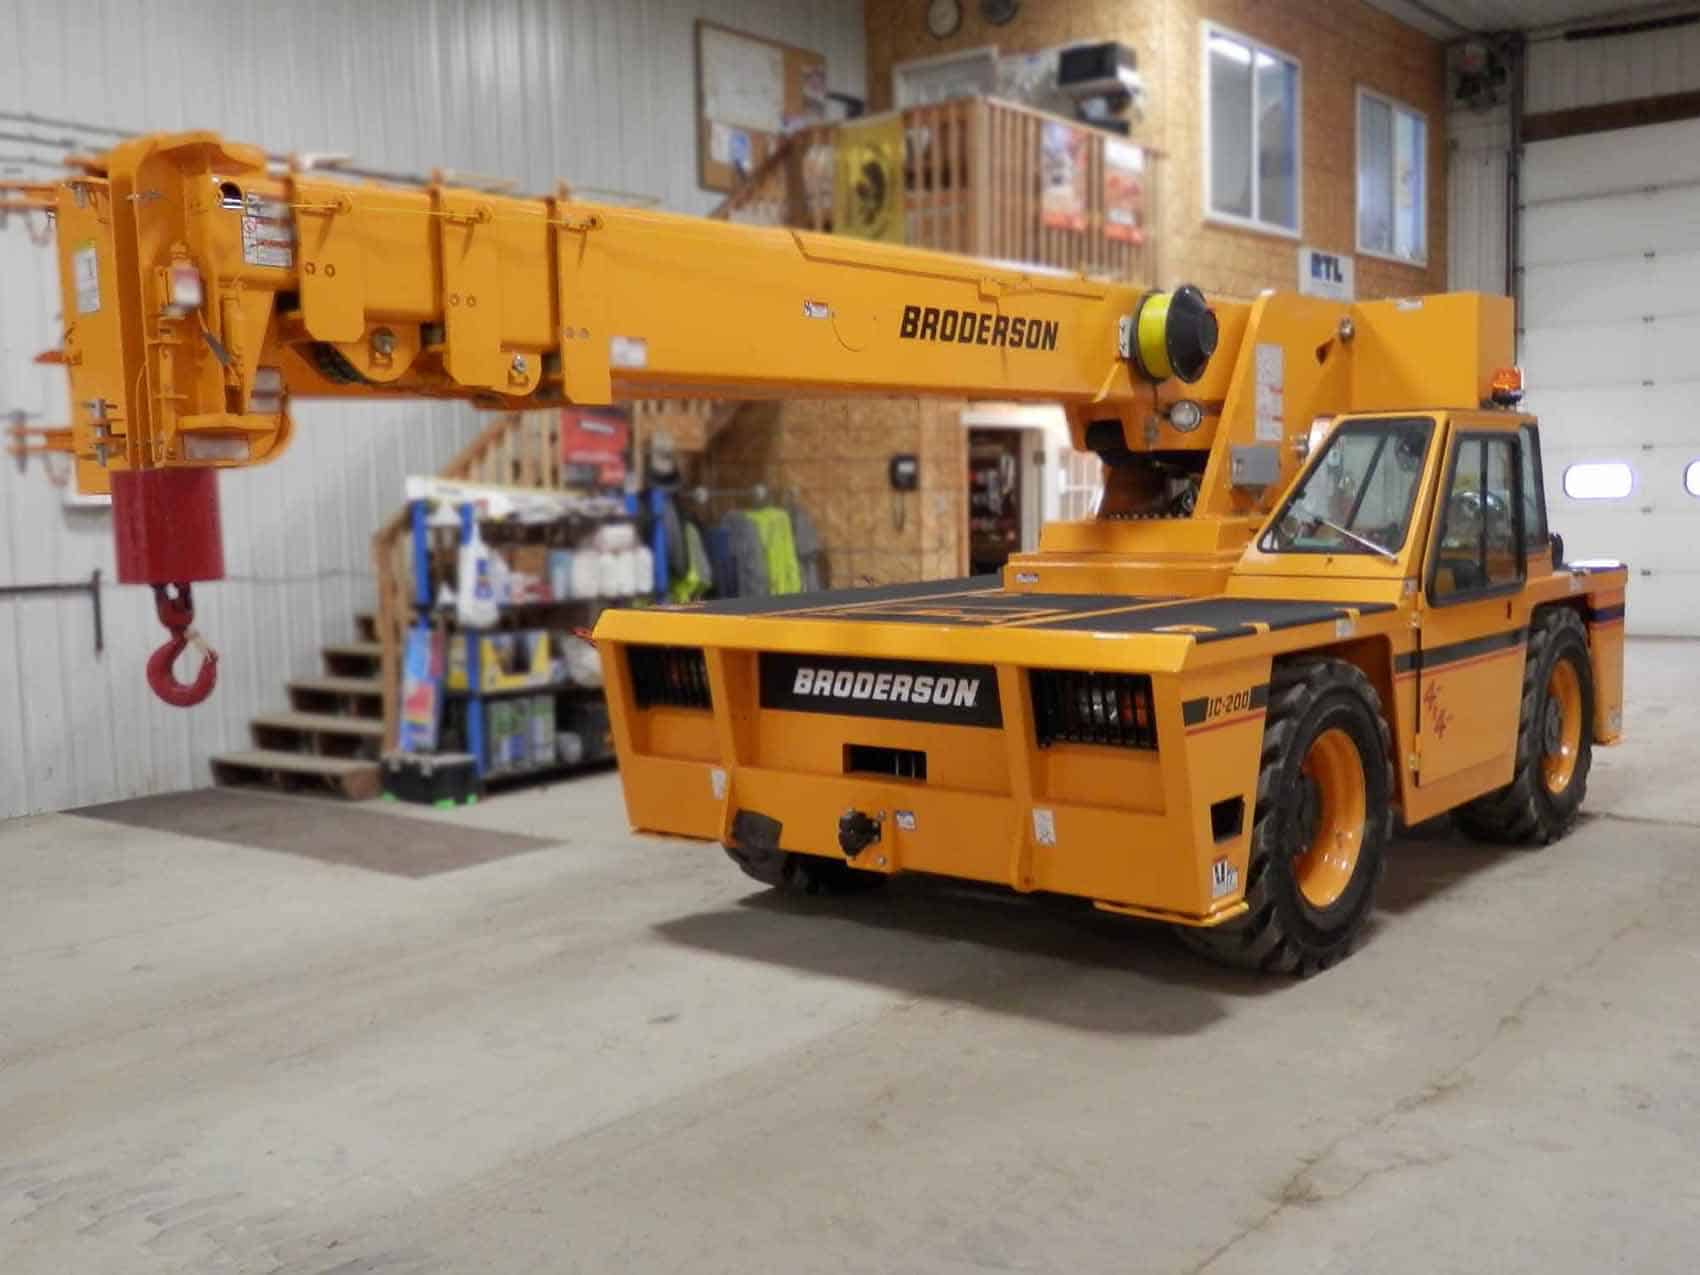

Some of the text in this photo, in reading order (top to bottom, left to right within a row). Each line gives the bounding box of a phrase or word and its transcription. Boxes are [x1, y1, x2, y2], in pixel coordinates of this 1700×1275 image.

[900, 305, 1059, 350] BRODERSON
[793, 667, 980, 707] BRODERSON
[1207, 689, 1250, 718] IC-200
